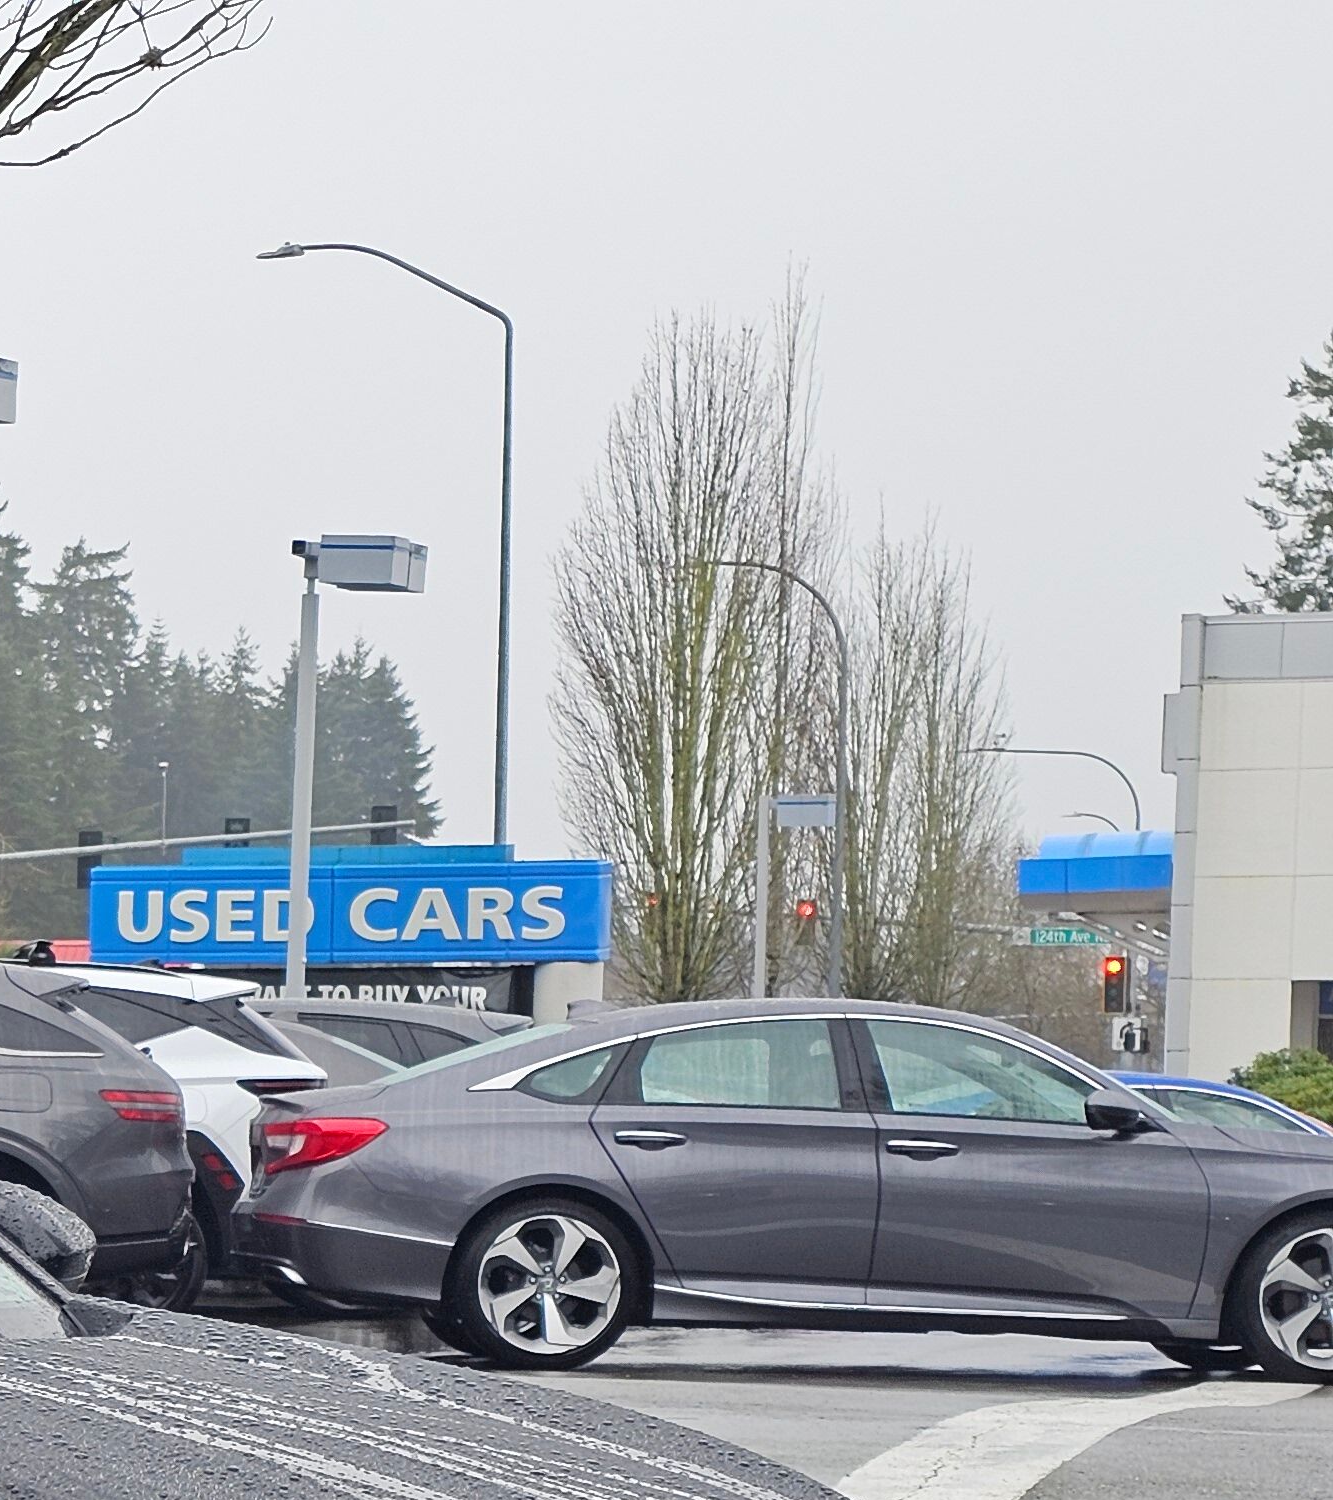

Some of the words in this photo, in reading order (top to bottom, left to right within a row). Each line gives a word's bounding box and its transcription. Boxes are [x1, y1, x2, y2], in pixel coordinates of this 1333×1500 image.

[117, 889, 315, 944] USED
[349, 885, 567, 943] CARS
[1035, 930, 1067, 943] 124th
[1070, 930, 1090, 943] Ave
[319, 984, 351, 1000] TO
[358, 984, 410, 1002] BUY
[417, 985, 487, 1010] YOUR
